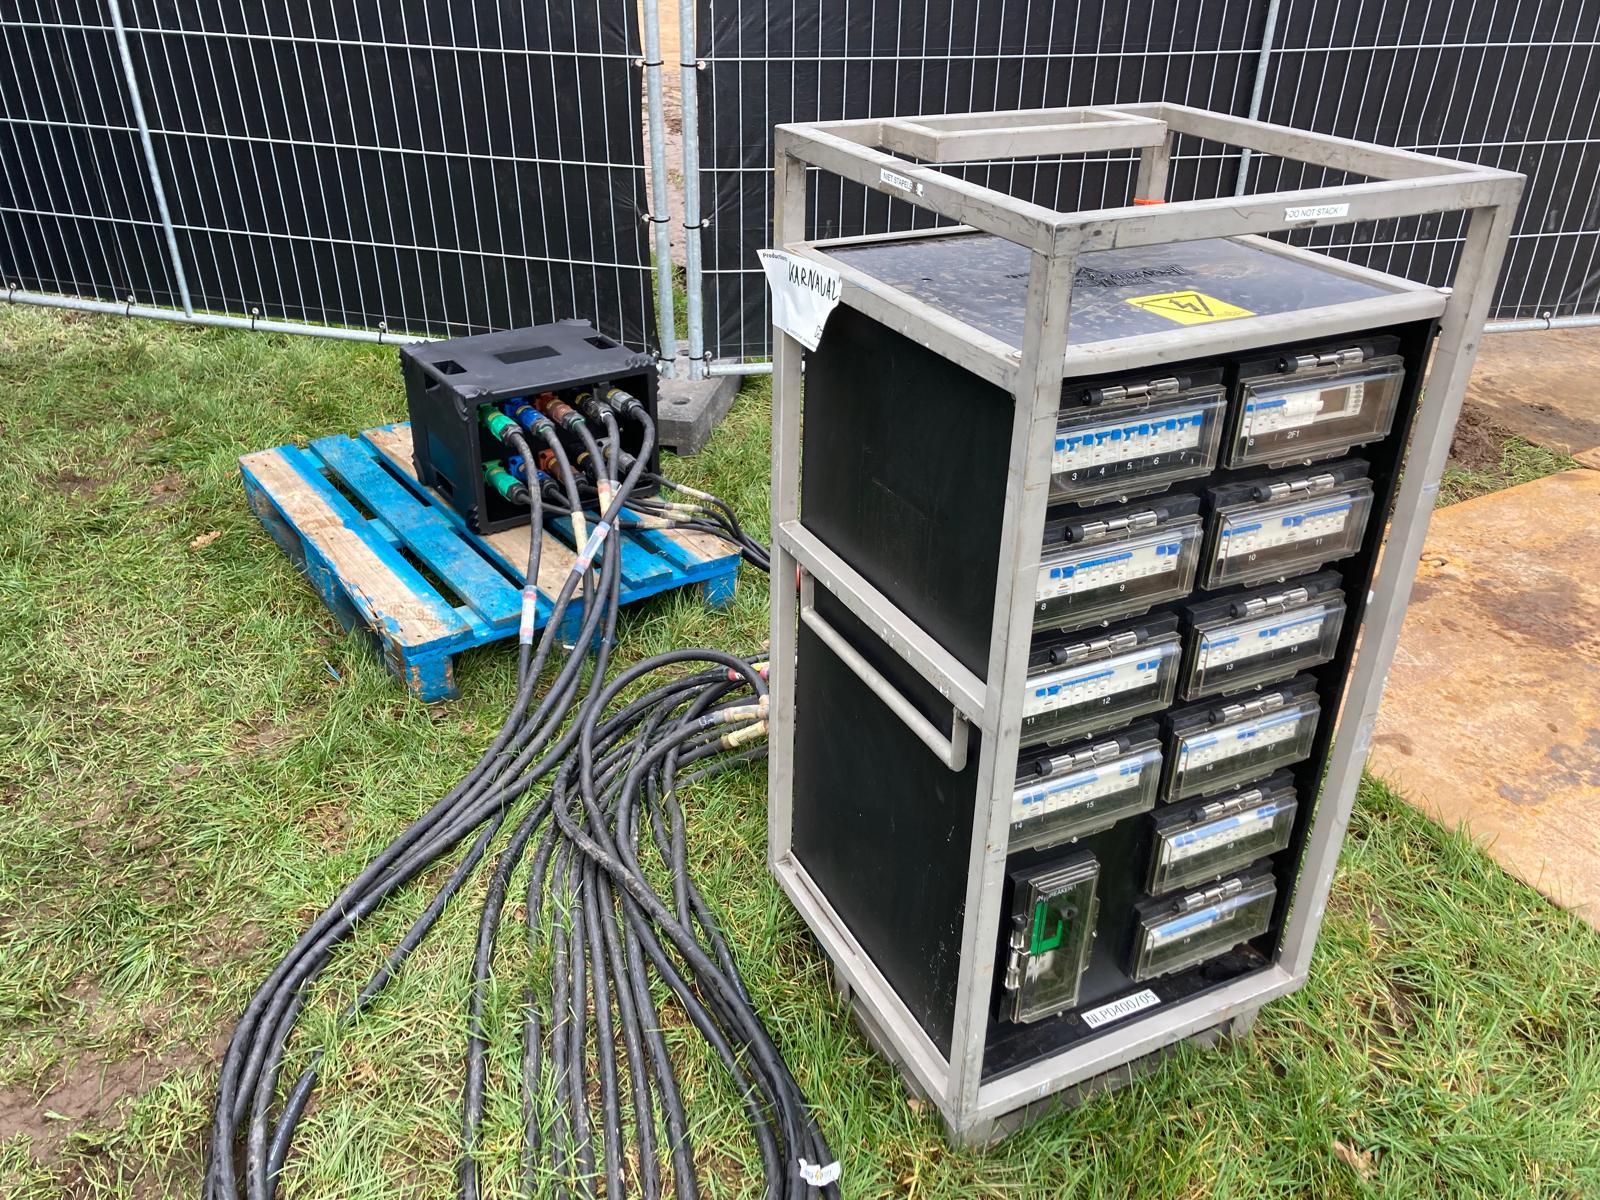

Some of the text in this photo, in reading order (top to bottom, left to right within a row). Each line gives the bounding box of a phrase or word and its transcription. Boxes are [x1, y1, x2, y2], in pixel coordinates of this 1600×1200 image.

[1301, 207, 1315, 217] NOT
[1317, 206, 1338, 216] STACK
[1248, 438, 1255, 446] 8
[1071, 451, 1186, 481] 3 4 5 6 7
[1040, 584, 1125, 611] 8 9
[1026, 697, 1111, 725] 11 12
[1014, 801, 1095, 830] 14 15
[1085, 991, 1156, 1025] NLPD400/05
